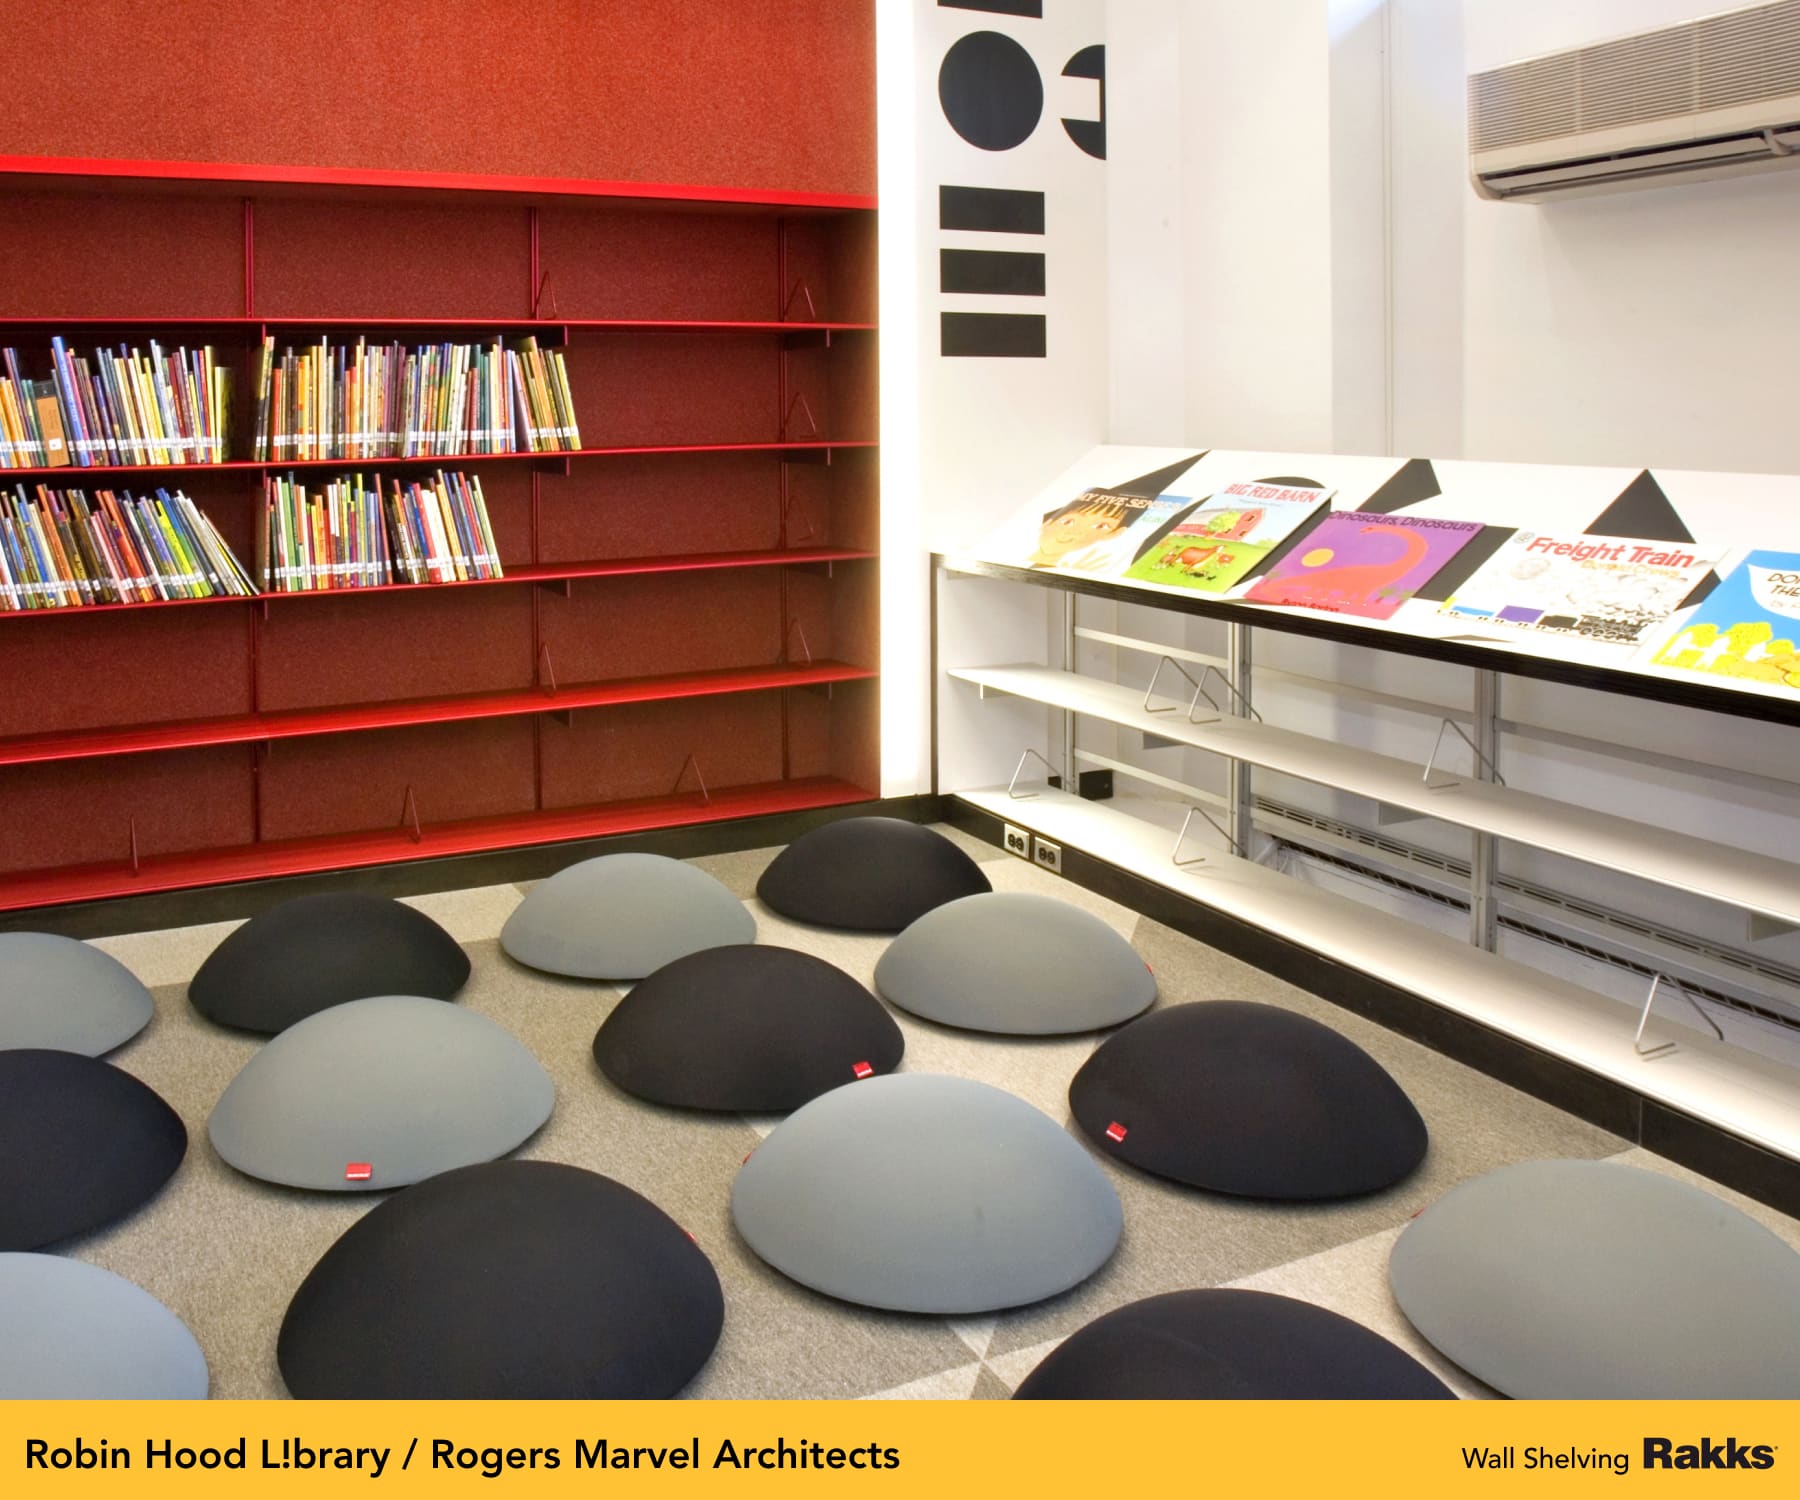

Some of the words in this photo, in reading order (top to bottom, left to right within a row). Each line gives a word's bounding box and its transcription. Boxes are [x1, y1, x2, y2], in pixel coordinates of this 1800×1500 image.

[1094, 494, 1129, 505] FIVE
[1223, 483, 1252, 496] BIG
[1247, 486, 1280, 500] RED
[1276, 490, 1321, 503] BARN
[1400, 516, 1477, 532] Dinosaurs
[1526, 537, 1626, 562] Freight
[1628, 546, 1695, 568] Train
